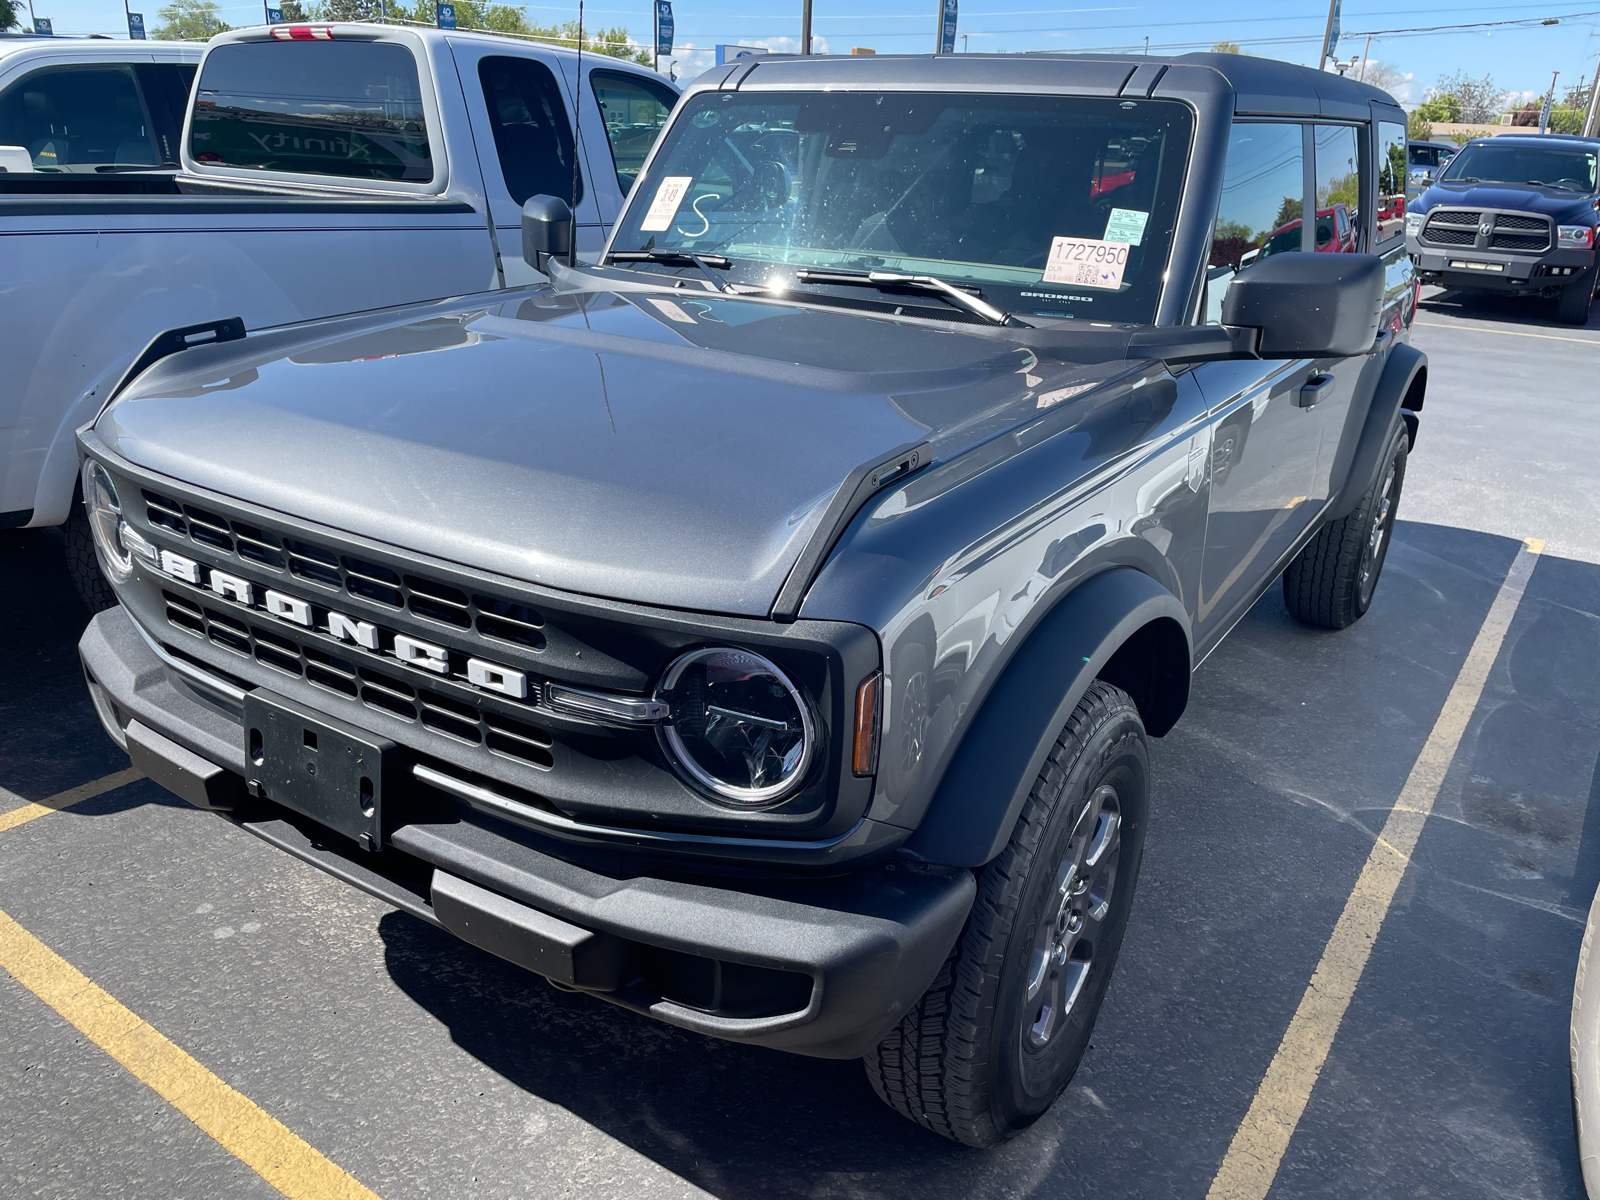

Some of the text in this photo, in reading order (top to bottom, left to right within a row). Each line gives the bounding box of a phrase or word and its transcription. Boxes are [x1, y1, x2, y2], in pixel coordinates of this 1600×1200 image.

[1056, 242, 1128, 266] 1727950
[1047, 265, 1063, 273] DLR
[1020, 291, 1093, 303] BRONCO
[161, 550, 528, 698] BRONCO
